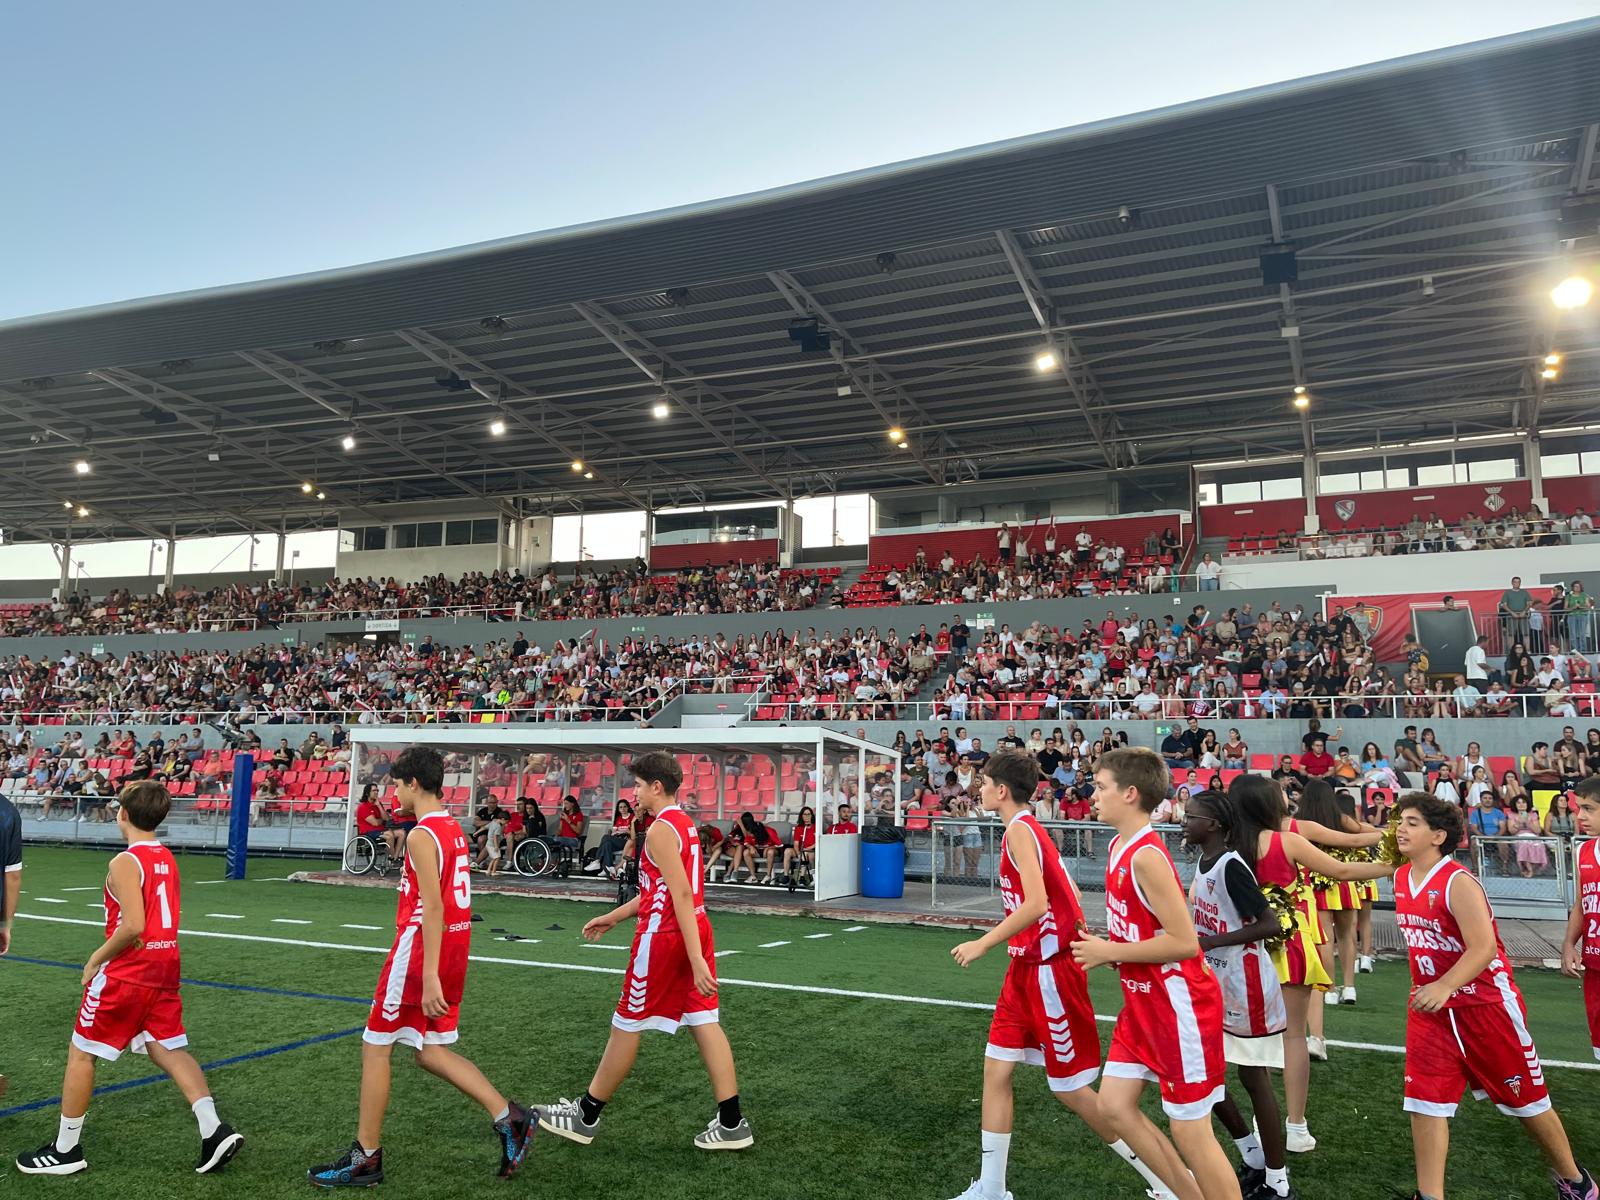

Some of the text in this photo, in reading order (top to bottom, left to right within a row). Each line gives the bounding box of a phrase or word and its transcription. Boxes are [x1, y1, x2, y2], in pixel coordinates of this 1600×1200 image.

[156, 880, 172, 929] 1
[453, 855, 471, 909] 5
[1415, 954, 1436, 976] 19
